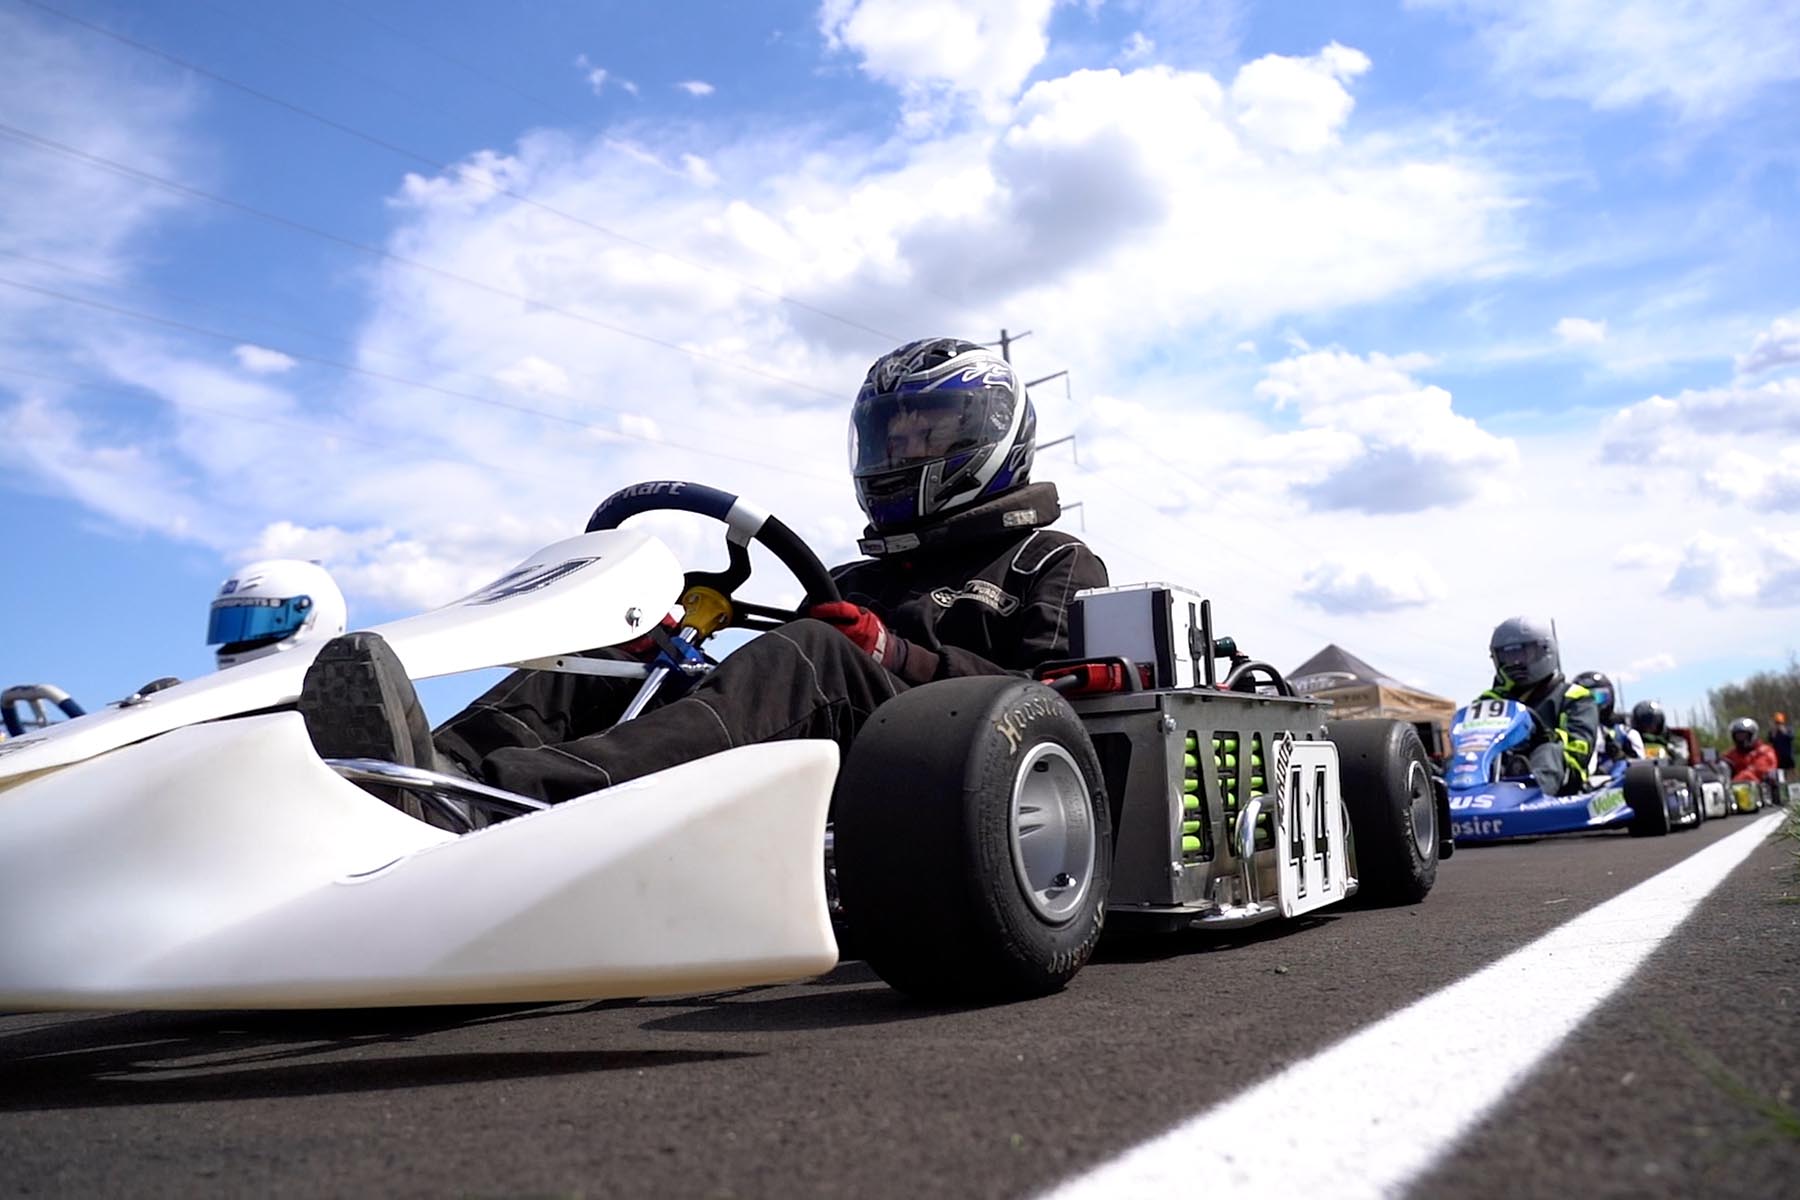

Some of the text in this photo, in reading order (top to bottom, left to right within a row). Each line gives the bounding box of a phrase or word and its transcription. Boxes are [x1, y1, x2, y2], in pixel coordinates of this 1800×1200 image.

[1471, 700, 1506, 720] 19
[1448, 794, 1496, 810] US
[1289, 764, 1332, 900] 44
